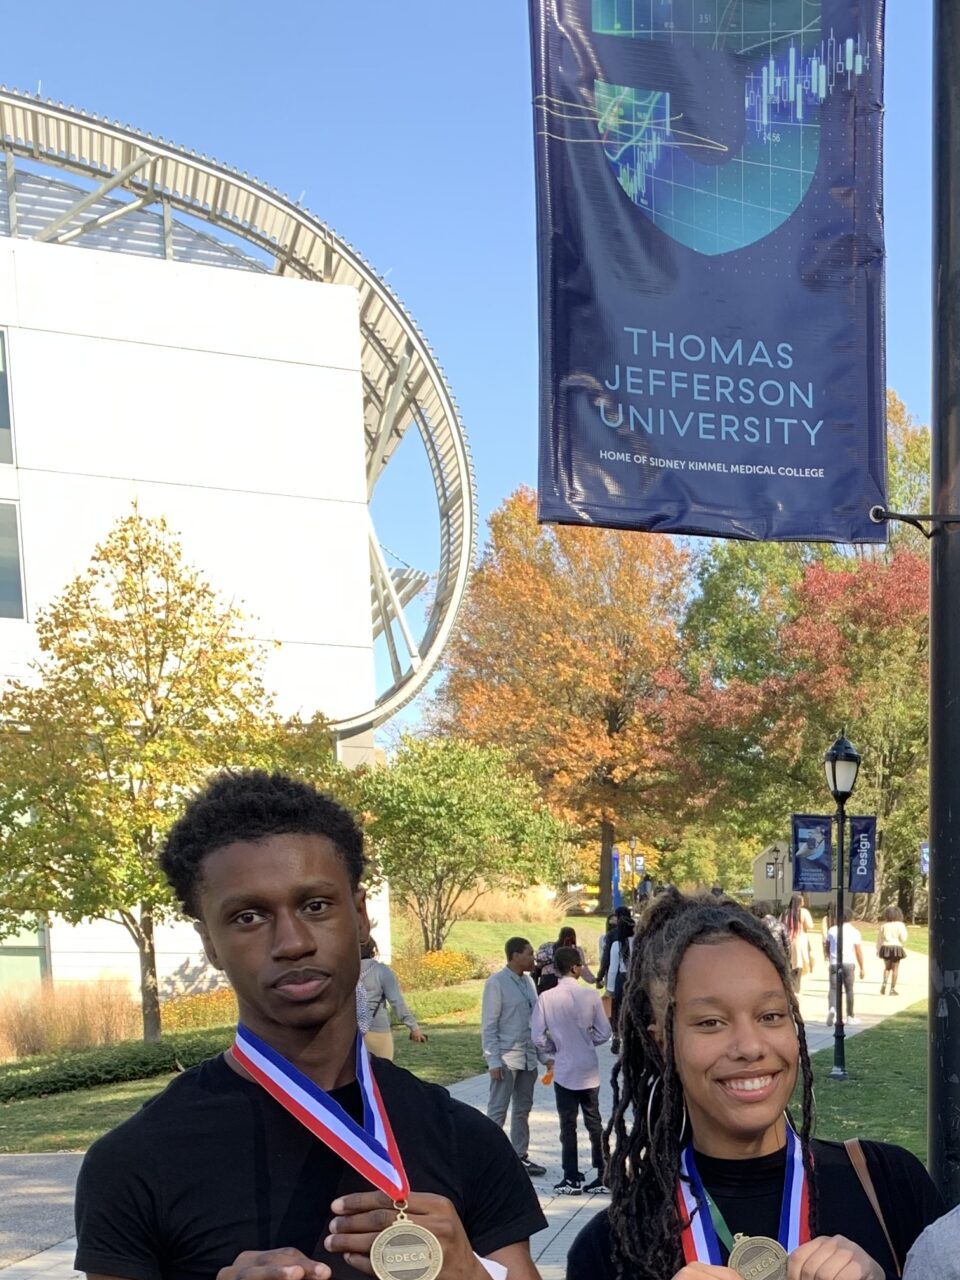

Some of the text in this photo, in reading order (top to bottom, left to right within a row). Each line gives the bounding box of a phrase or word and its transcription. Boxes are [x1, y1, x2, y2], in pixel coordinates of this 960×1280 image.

[623, 327, 793, 369] THOMAS
[605, 364, 813, 408] JEFFERSON
[600, 399, 824, 446] UNIVERSITY
[600, 450, 825, 478] HOME OF SIDNEY KIMMEL MEDICAL COLLEGE
[856, 833, 871, 875] Design
[395, 1252, 426, 1263] DECA
[750, 1256, 777, 1277] DECA
